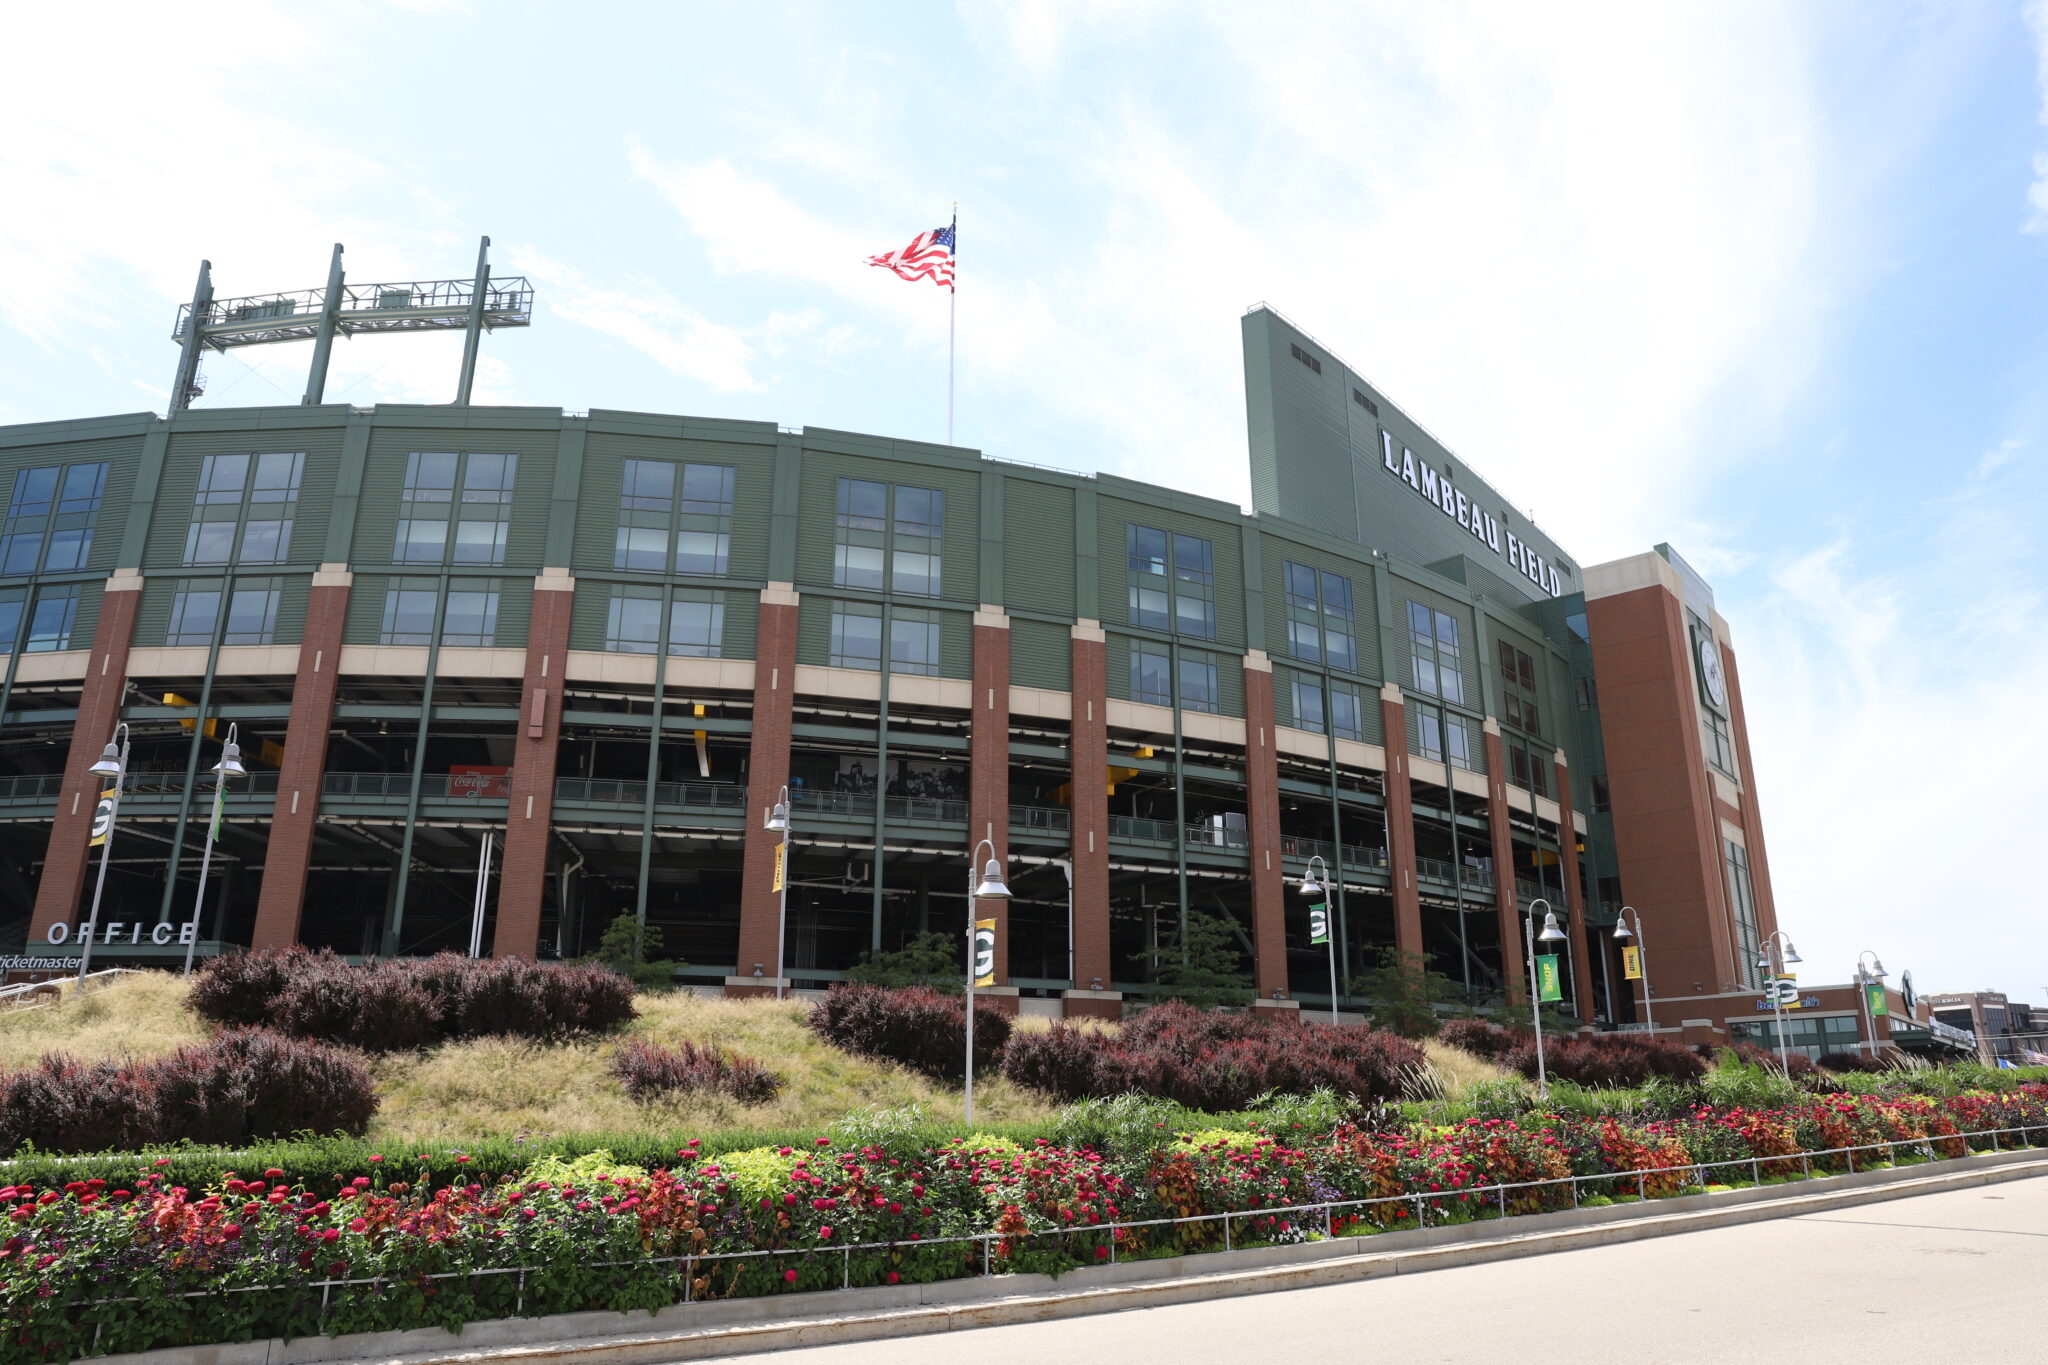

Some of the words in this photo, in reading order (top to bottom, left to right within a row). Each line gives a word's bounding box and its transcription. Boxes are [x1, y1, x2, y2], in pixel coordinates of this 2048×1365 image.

[1382, 430, 1500, 555] LAMBEAU
[1506, 531, 1561, 598] FIELD
[91, 799, 113, 839] G
[47, 921, 196, 945] OFFICE
[1310, 910, 1327, 938] G
[975, 929, 995, 977] G
[1627, 953, 1636, 972] DINE
[1543, 963, 1554, 992] SHOP
